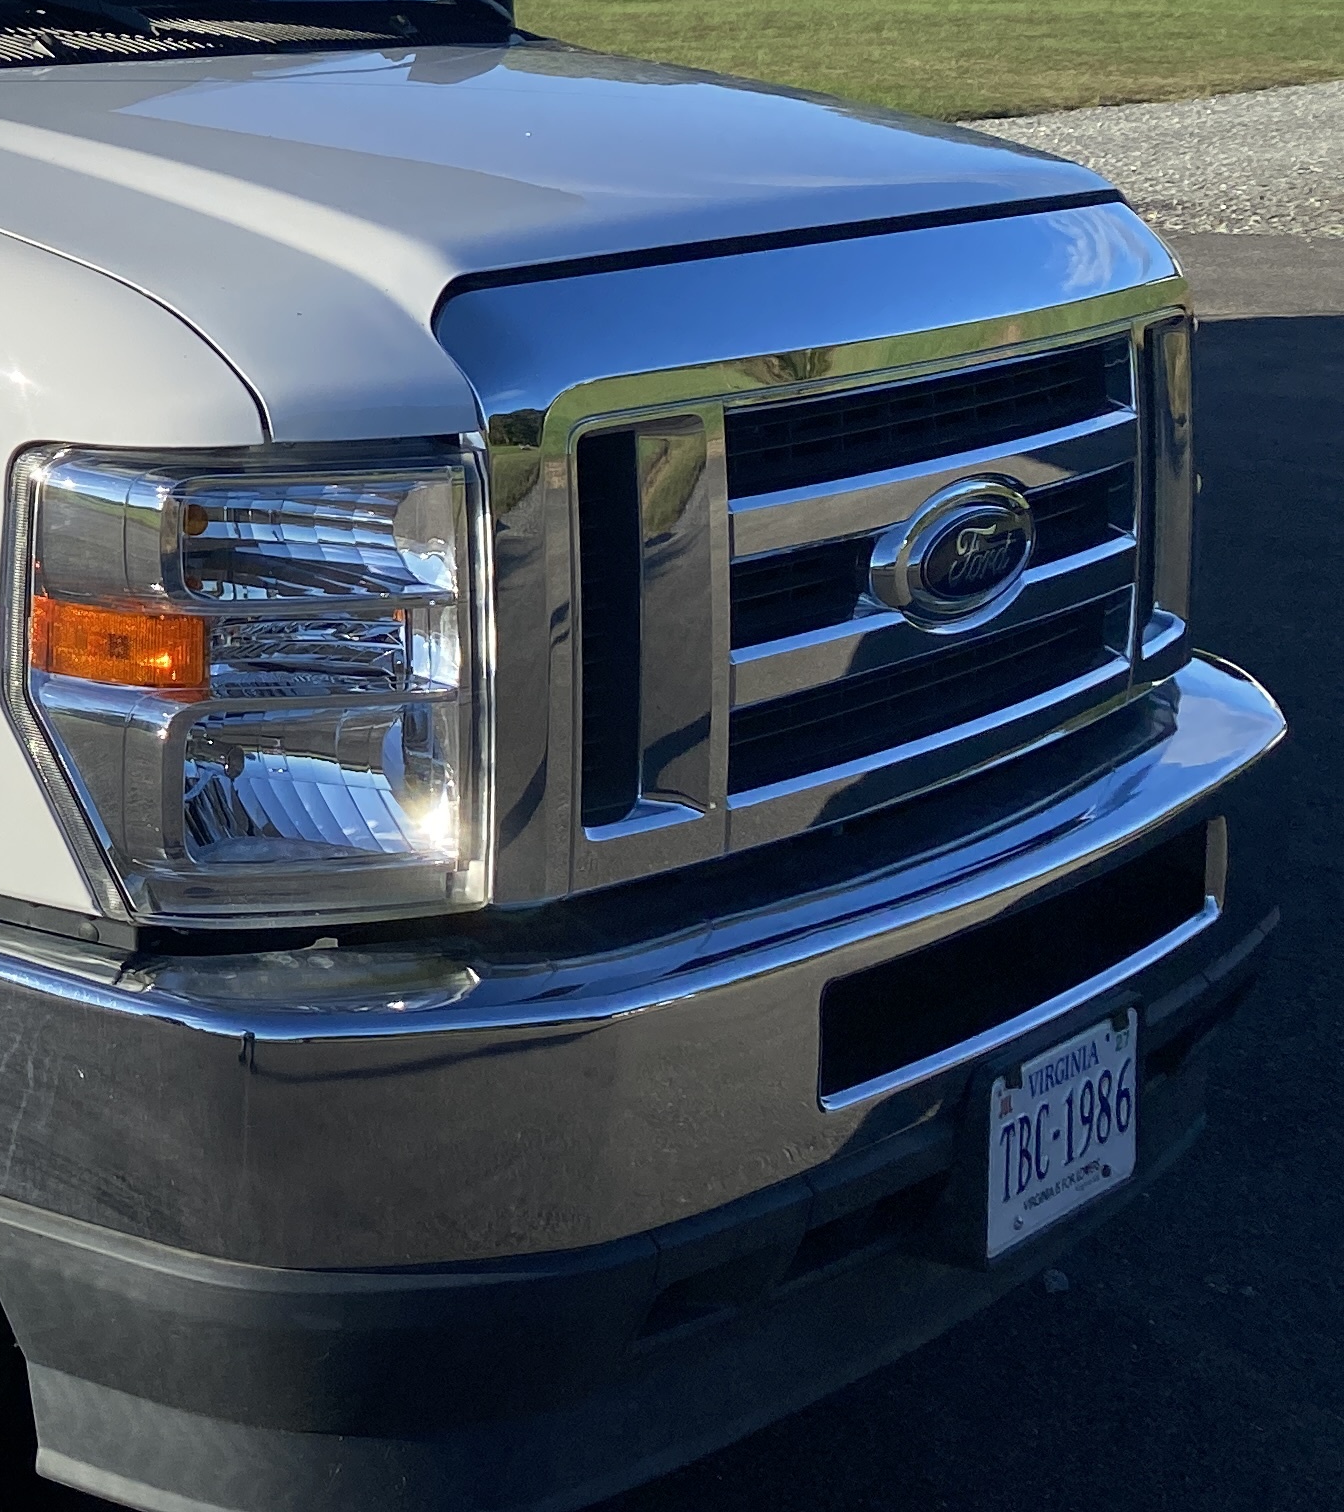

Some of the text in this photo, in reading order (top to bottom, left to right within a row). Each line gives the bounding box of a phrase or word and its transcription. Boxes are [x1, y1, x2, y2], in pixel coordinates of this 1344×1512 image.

[948, 523, 1016, 587] Ford
[1028, 1040, 1100, 1098] VIRGINIA
[1000, 1057, 1132, 1204] TBC-1986
